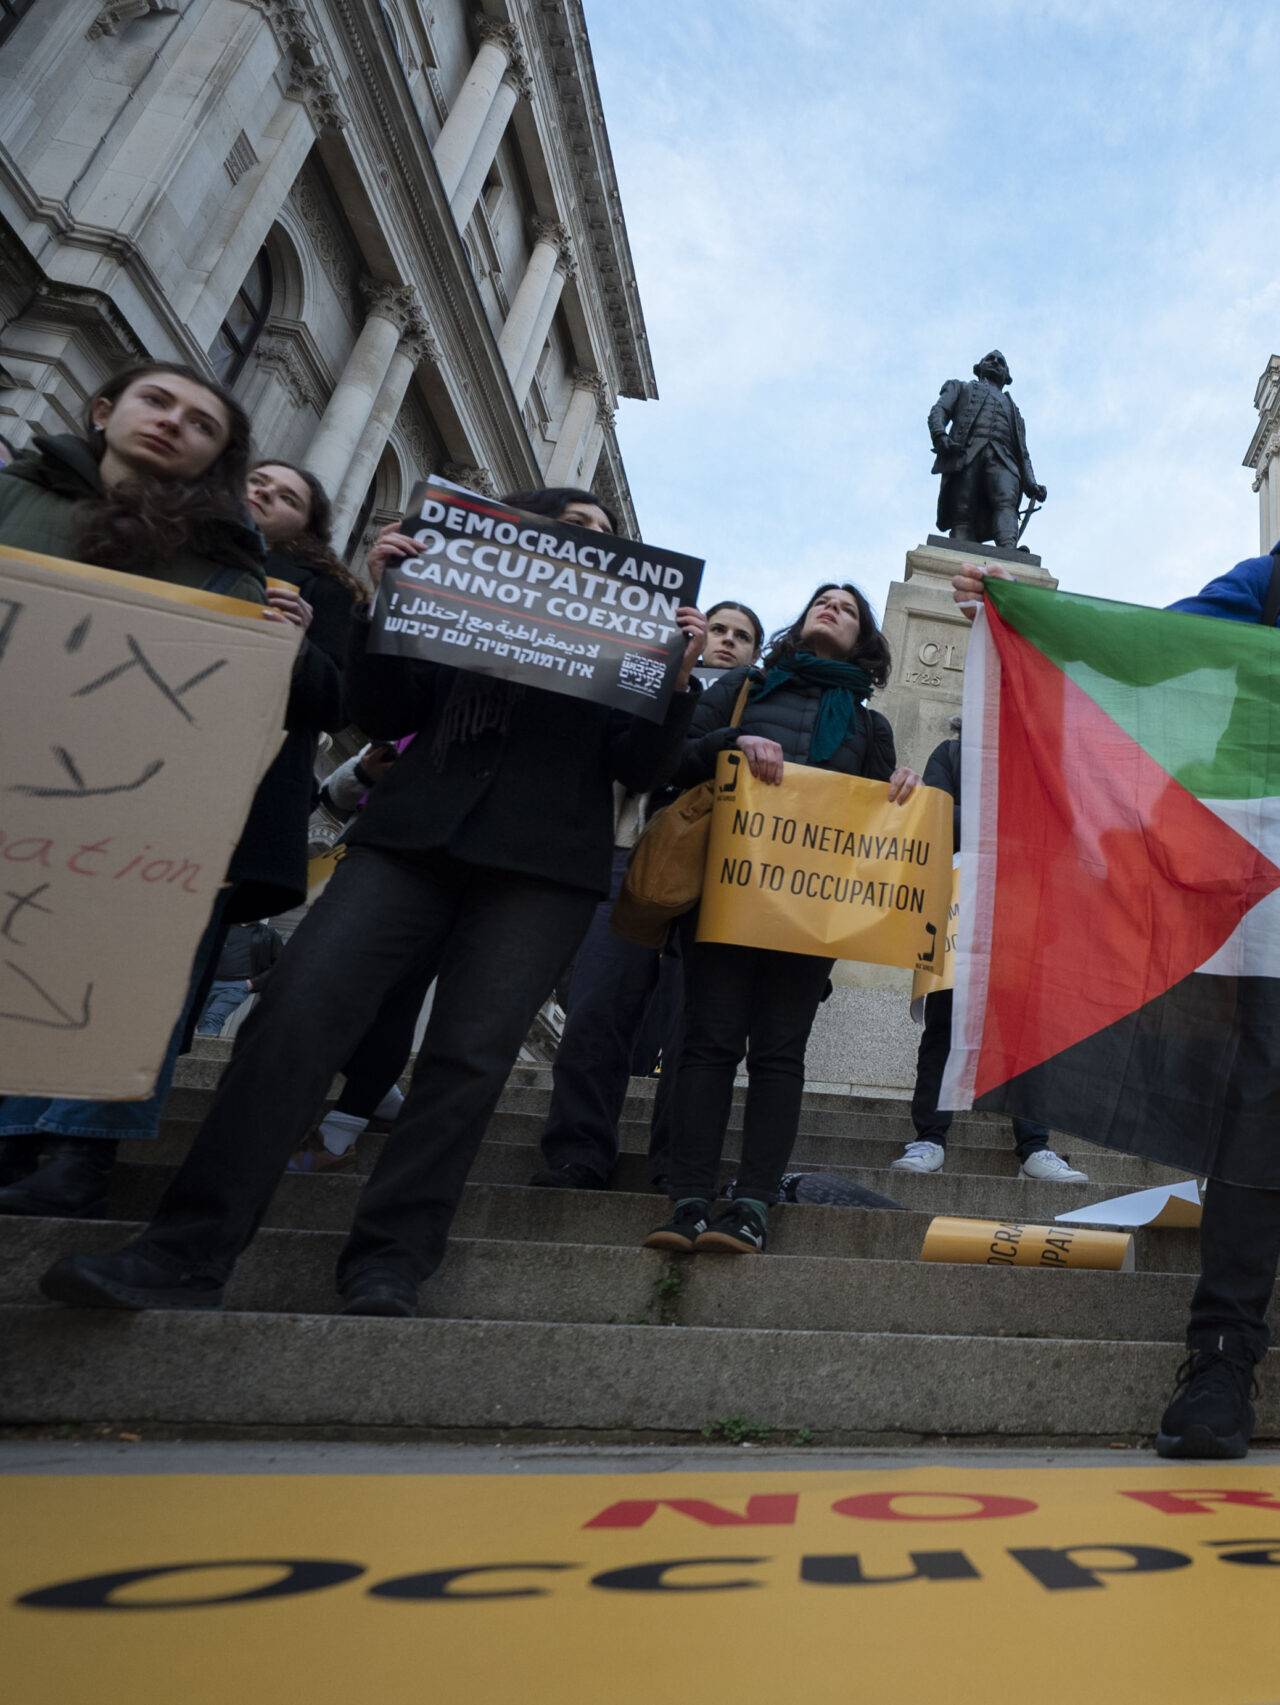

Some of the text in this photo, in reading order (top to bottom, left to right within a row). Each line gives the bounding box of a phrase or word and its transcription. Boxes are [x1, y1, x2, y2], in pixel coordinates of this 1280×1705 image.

[420, 499, 684, 590] DEMOCRACY AND
[401, 557, 676, 645] CANNOT COEXIST
[413, 528, 680, 622] OCCUPATION
[384, 616, 440, 639] כיבוש
[442, 628, 472, 647] עם
[567, 660, 595, 679] אין
[732, 809, 931, 867] NO TO NETANYAHU
[720, 857, 752, 885] NO
[758, 863, 785, 892] TO
[790, 870, 925, 914] OCCUPATION
[580, 1490, 1040, 1530] NO
